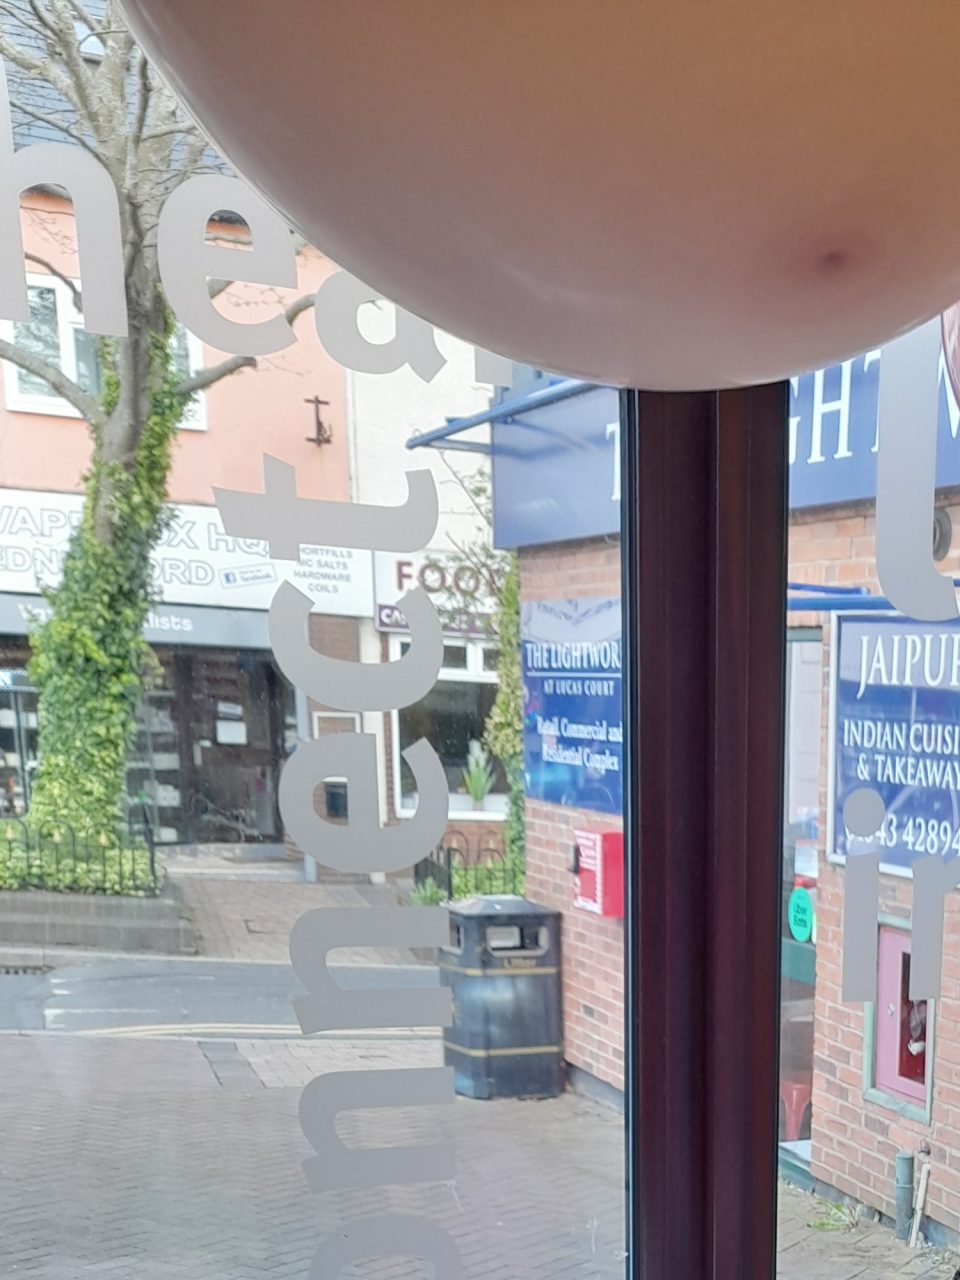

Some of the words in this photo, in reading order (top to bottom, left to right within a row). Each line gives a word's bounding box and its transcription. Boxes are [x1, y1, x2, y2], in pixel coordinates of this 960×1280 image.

[525, 642, 549, 669] THE
[550, 639, 622, 670] LIGHTWOR
[556, 679, 583, 697] LUCAS
[584, 679, 615, 697] COURT
[560, 718, 607, 742] Commercial
[842, 719, 907, 750] INDIAN
[583, 747, 620, 775] Complex
[856, 753, 870, 781] &
